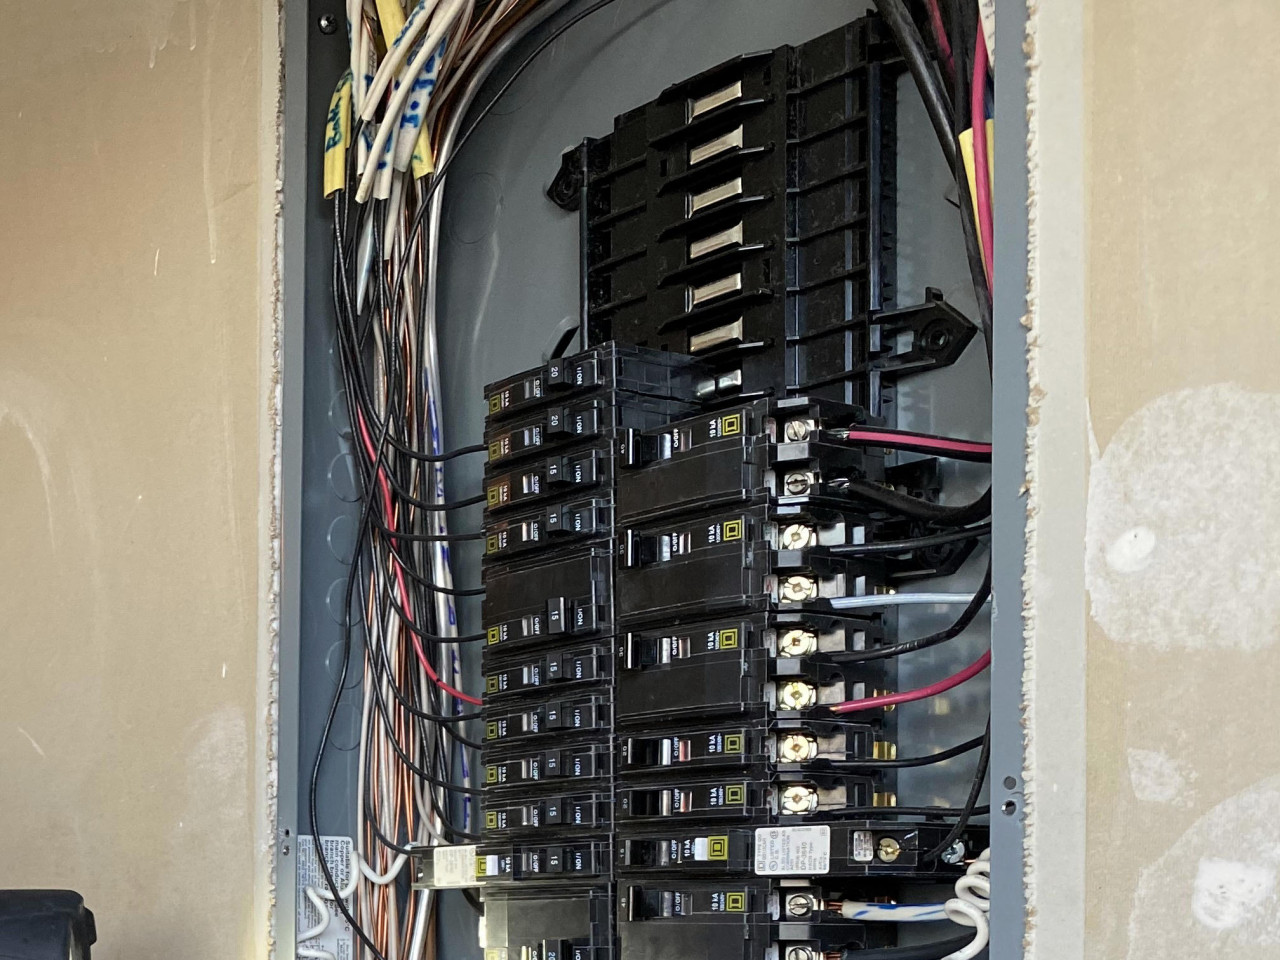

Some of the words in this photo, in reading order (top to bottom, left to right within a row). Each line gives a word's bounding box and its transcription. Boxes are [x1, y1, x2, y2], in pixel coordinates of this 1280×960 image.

[551, 366, 558, 378] 20
[551, 415, 558, 426] 20
[710, 419, 716, 428] kA
[710, 428, 716, 437] 10
[550, 464, 557, 474] 15
[550, 513, 557, 523] 15
[709, 525, 715, 534] kA
[709, 535, 715, 543] 10
[551, 611, 559, 620] 15
[708, 631, 714, 641] kA
[708, 642, 714, 650] 10
[550, 662, 557, 672] 15
[549, 710, 556, 720] 15
[709, 735, 716, 744] kA
[548, 758, 556, 768] 15
[710, 788, 717, 797] kA
[550, 807, 556, 816] 15
[684, 839, 690, 848] kA
[684, 849, 690, 857] 10
[551, 856, 558, 865] 15
[712, 892, 719, 902] kA
[712, 902, 719, 910] 10
[548, 952, 556, 960] 20
